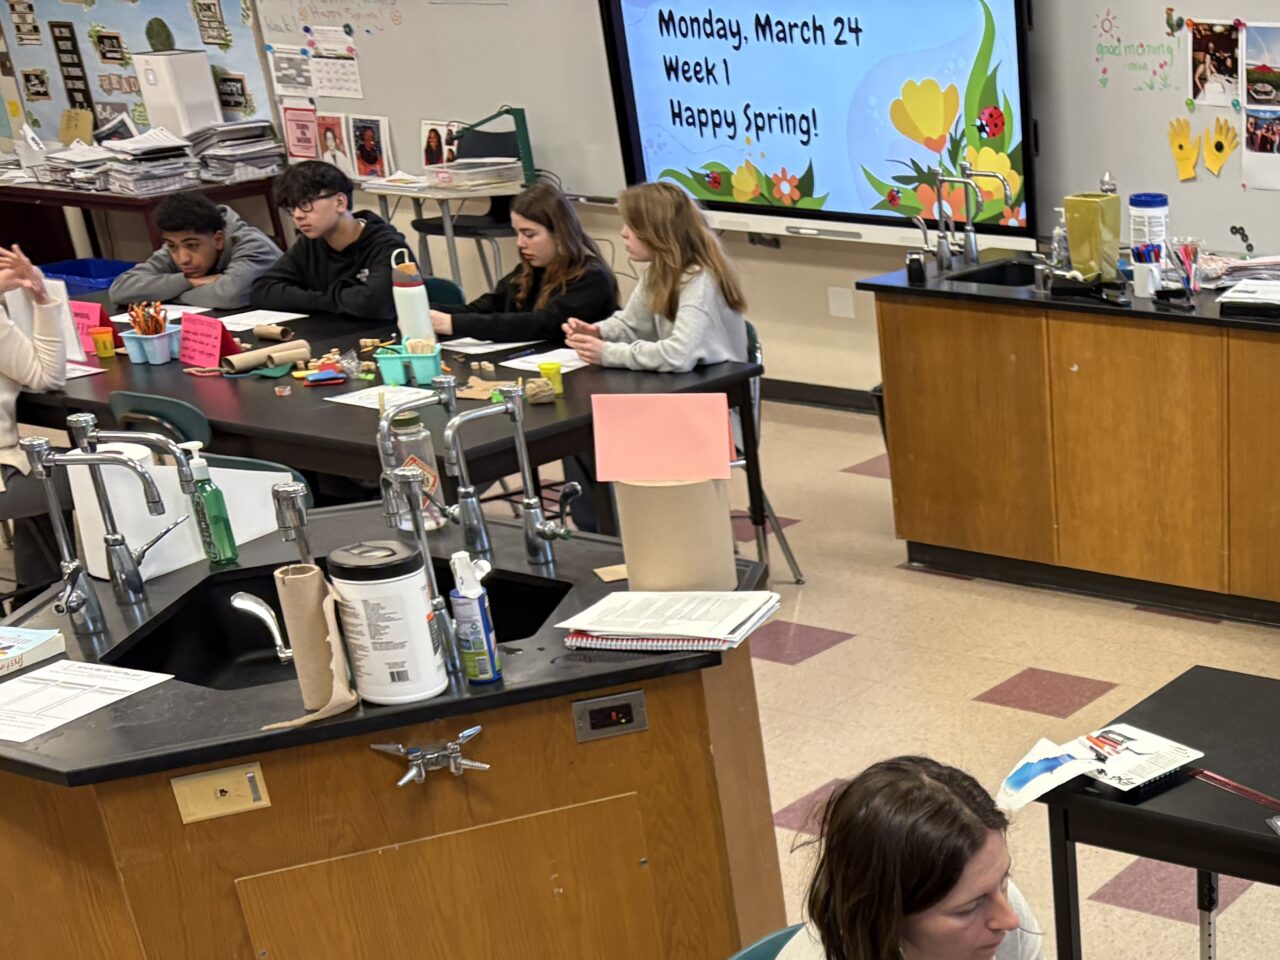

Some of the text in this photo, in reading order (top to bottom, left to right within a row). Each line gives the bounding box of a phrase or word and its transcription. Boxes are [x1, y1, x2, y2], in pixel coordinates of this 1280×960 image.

[658, 8, 863, 51] Monday, March 24
[1096, 42, 1121, 61] good
[663, 55, 730, 85] Week 1
[670, 99, 818, 146] Happy Spring!
